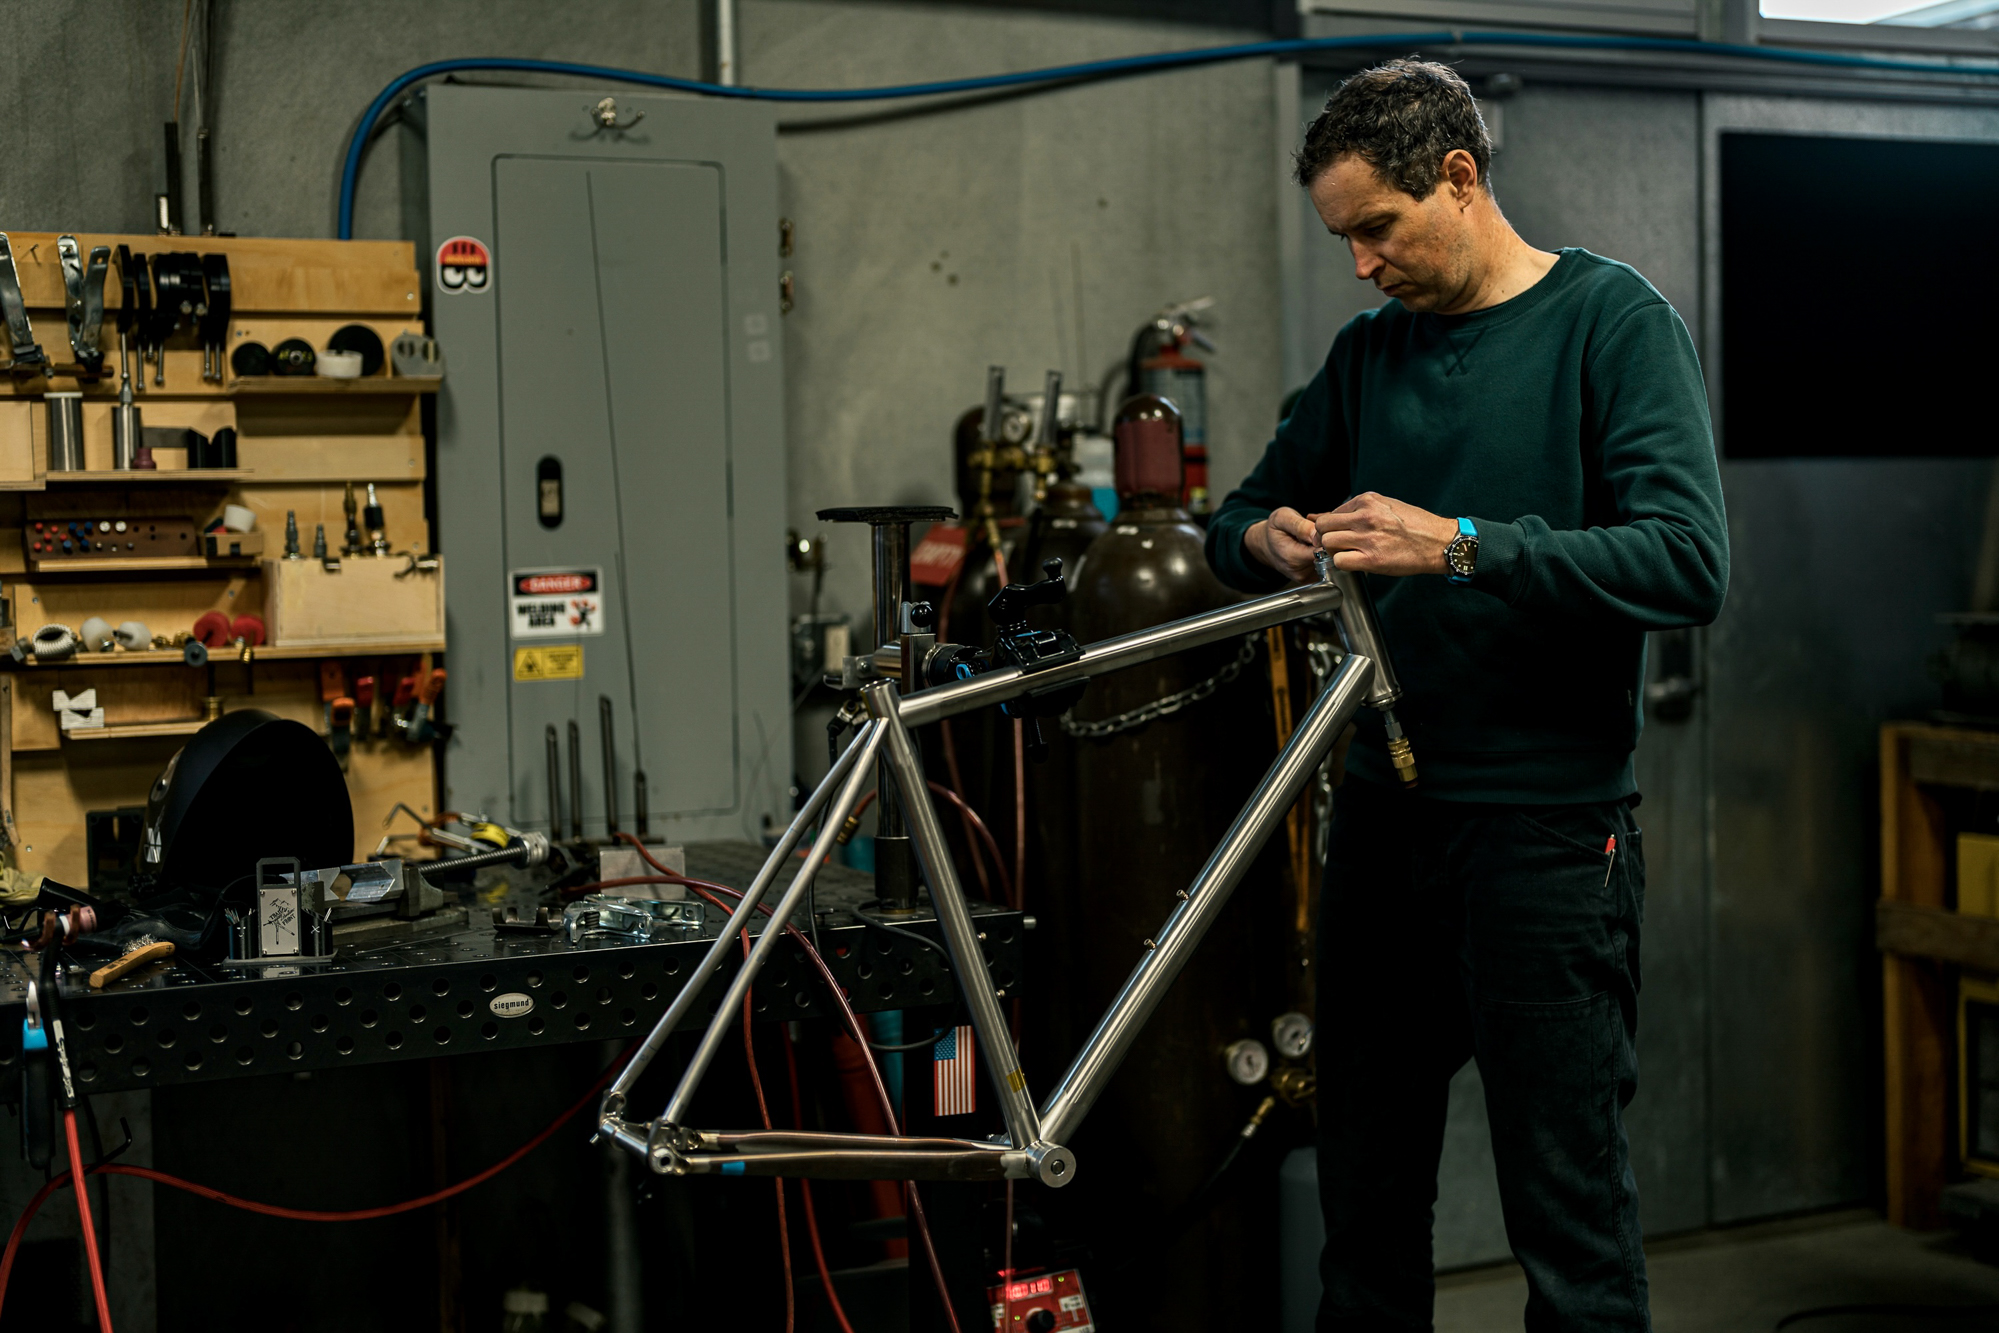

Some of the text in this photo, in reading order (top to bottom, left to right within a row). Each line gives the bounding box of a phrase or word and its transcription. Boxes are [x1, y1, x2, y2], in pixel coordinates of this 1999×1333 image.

[529, 576, 581, 593] DANGER
[517, 602, 565, 615] WELDING
[528, 614, 555, 626] AREA
[494, 998, 530, 1010] siegmund
